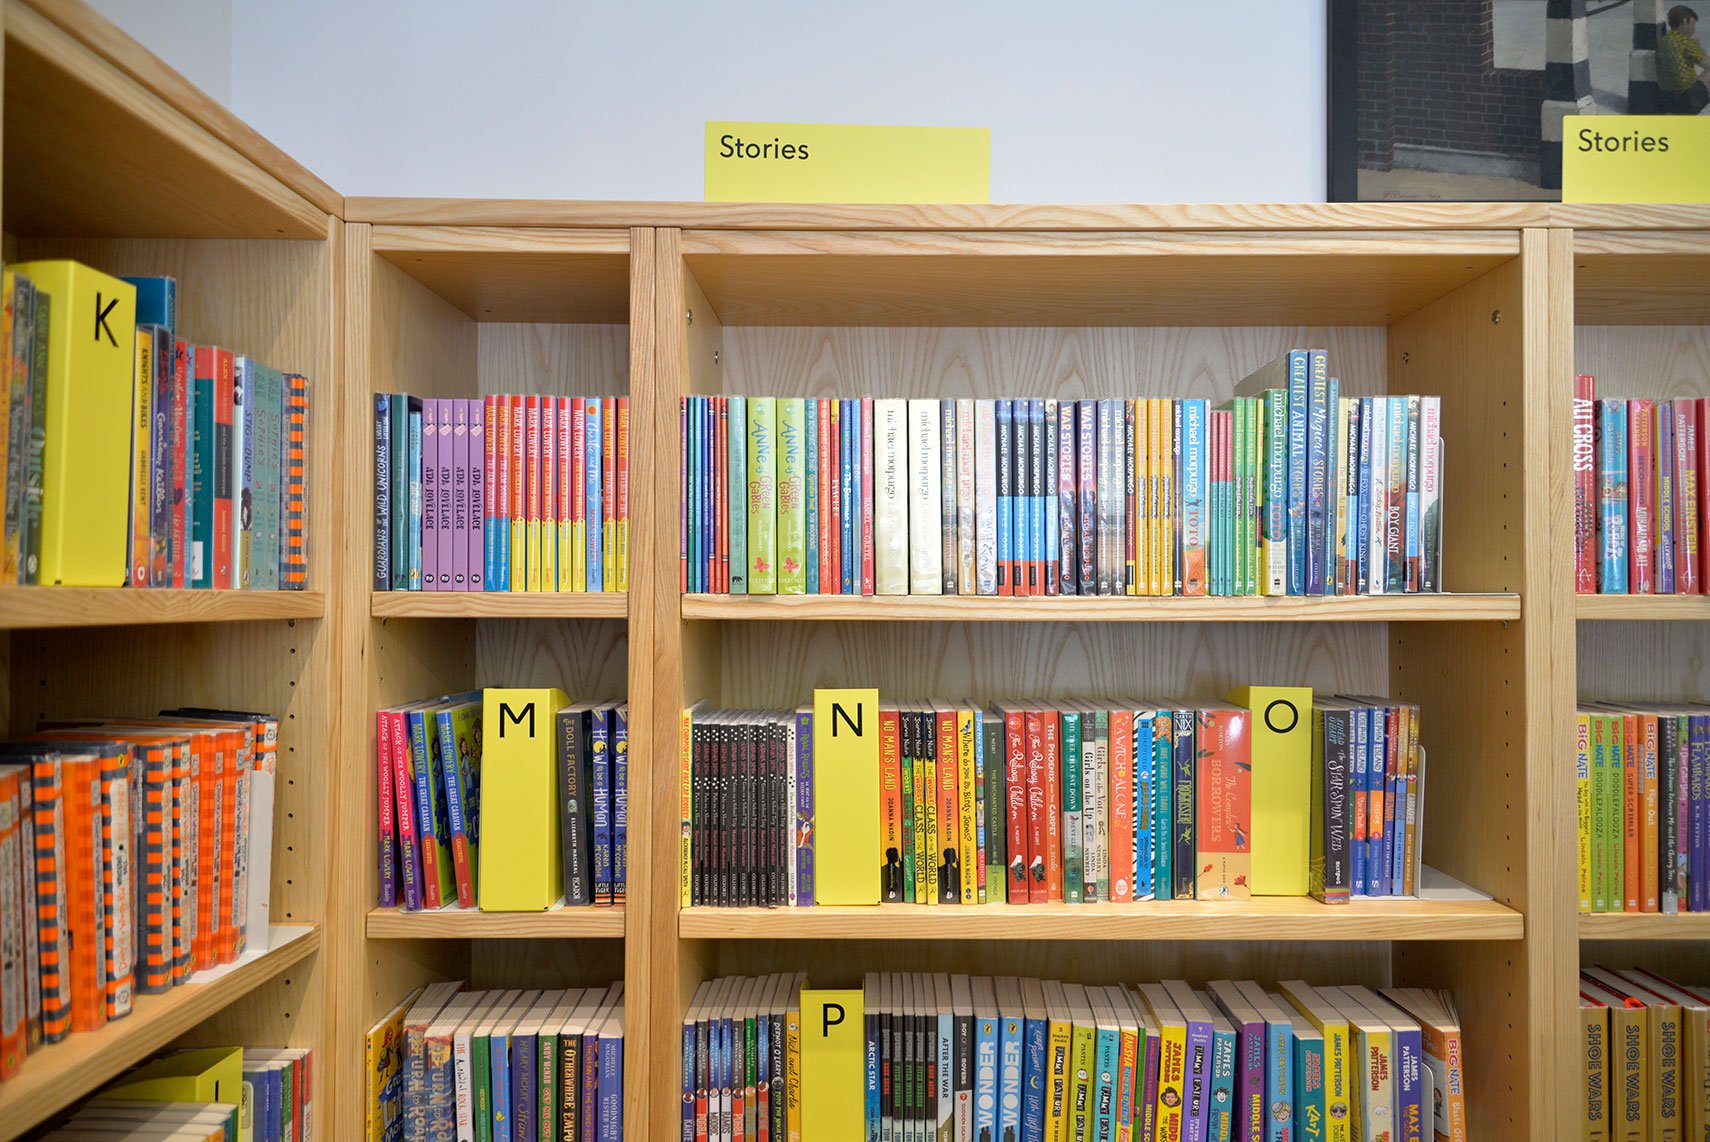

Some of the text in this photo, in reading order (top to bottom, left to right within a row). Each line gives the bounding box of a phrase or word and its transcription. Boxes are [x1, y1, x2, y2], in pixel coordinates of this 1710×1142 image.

[720, 135, 809, 160] Stories
[1578, 128, 1669, 152] Stories
[94, 291, 120, 348] K
[244, 410, 252, 481] STIG DUMP
[513, 406, 522, 457] MARK LOWERY
[528, 407, 537, 458] MARK LOWERY
[1061, 406, 1072, 480] WAR STORIES
[1082, 405, 1092, 481] WAR STORIES
[1292, 357, 1306, 498] GREATEST ANIMAL STORIES
[1312, 354, 1326, 497] GREATEST Magical STORIES
[1574, 399, 1593, 472] ALI CROSS
[27, 426, 45, 528] Outside
[155, 412, 167, 513] Garrison Keillor
[377, 445, 386, 490] UNICORNS
[884, 410, 897, 499] michael morpurgo
[1187, 406, 1200, 547] michael morpurgo TOTO
[1270, 393, 1285, 540] michael morpurgo TOTO
[425, 467, 434, 530] ADA LOVELACE
[440, 467, 449, 530] ADA LOVELACE
[1685, 469, 1696, 554] MAX EINSTEIN
[377, 529, 386, 579] GUARDIANS
[1389, 506, 1400, 554] BOY GIANT
[499, 703, 535, 738] M
[832, 703, 863, 737] N
[1265, 700, 1299, 734] O
[1328, 716, 1337, 744] O'HART
[1595, 720, 1603, 744] BiG
[566, 726, 577, 796] DOLL FACTORY
[884, 720, 895, 791] NO MAN'S LAND
[942, 720, 953, 791] NO MAN'S LAND
[962, 732, 971, 779] Where do you
[1007, 749, 1024, 783] Railway
[1097, 746, 1106, 769] Girls
[1578, 724, 1588, 778] BiG NATE
[1595, 744, 1603, 767] NATE
[1646, 723, 1656, 777] BiG NATE
[1691, 742, 1702, 800] FLAMBARDS
[418, 776, 430, 831] THE GREAT CARAVAN
[1010, 786, 1022, 819] Children
[1047, 723, 1057, 837] THE PHOENIX CARPET
[1082, 752, 1094, 819] Girls on the Up
[1097, 795, 1105, 815] Vote
[1115, 779, 1127, 819] ALONE
[1177, 780, 1192, 824] FROGKISSER!
[1211, 759, 1221, 842] BORROWERS
[962, 791, 972, 841] Birdy Jones?
[914, 805, 926, 883] CLASS WORLD
[926, 805, 937, 884] CLASS WORLD
[572, 877, 581, 899] PICADOR
[823, 1004, 846, 1038] P
[773, 1022, 781, 1075] DERMOT O'LEARY
[788, 1034, 798, 1109] Nick and Charlie
[1124, 1033, 1137, 1066] ANISHA
[1171, 1043, 1182, 1081] JAMES
[1222, 1040, 1232, 1077] JAMES
[1334, 1033, 1342, 1097] JAMES PATTERSON
[1588, 1024, 1602, 1121] SHOE WARS
[1626, 1025, 1640, 1121] SHOE WARS
[1662, 1022, 1676, 1118] SHOE WARS
[564, 1049, 577, 1109] OTHERWHERE
[979, 1042, 994, 1129] WONDER
[1004, 1041, 1020, 1128] WONDER
[1052, 1046, 1065, 1117] TIMMY FAILURE
[1076, 1084, 1087, 1111] TIMMY
[1191, 1046, 1204, 1116] TIMMY FAILURE
[697, 1113, 706, 1136] POGBA
[709, 1112, 718, 1136] MODRIC
[721, 1111, 730, 1134] RAMOS
[733, 1113, 743, 1136] POGBA
[1211, 1108, 1219, 1129] FROM
[1252, 1094, 1260, 1132] MIDDLE
[1409, 1104, 1419, 1134] MAX
